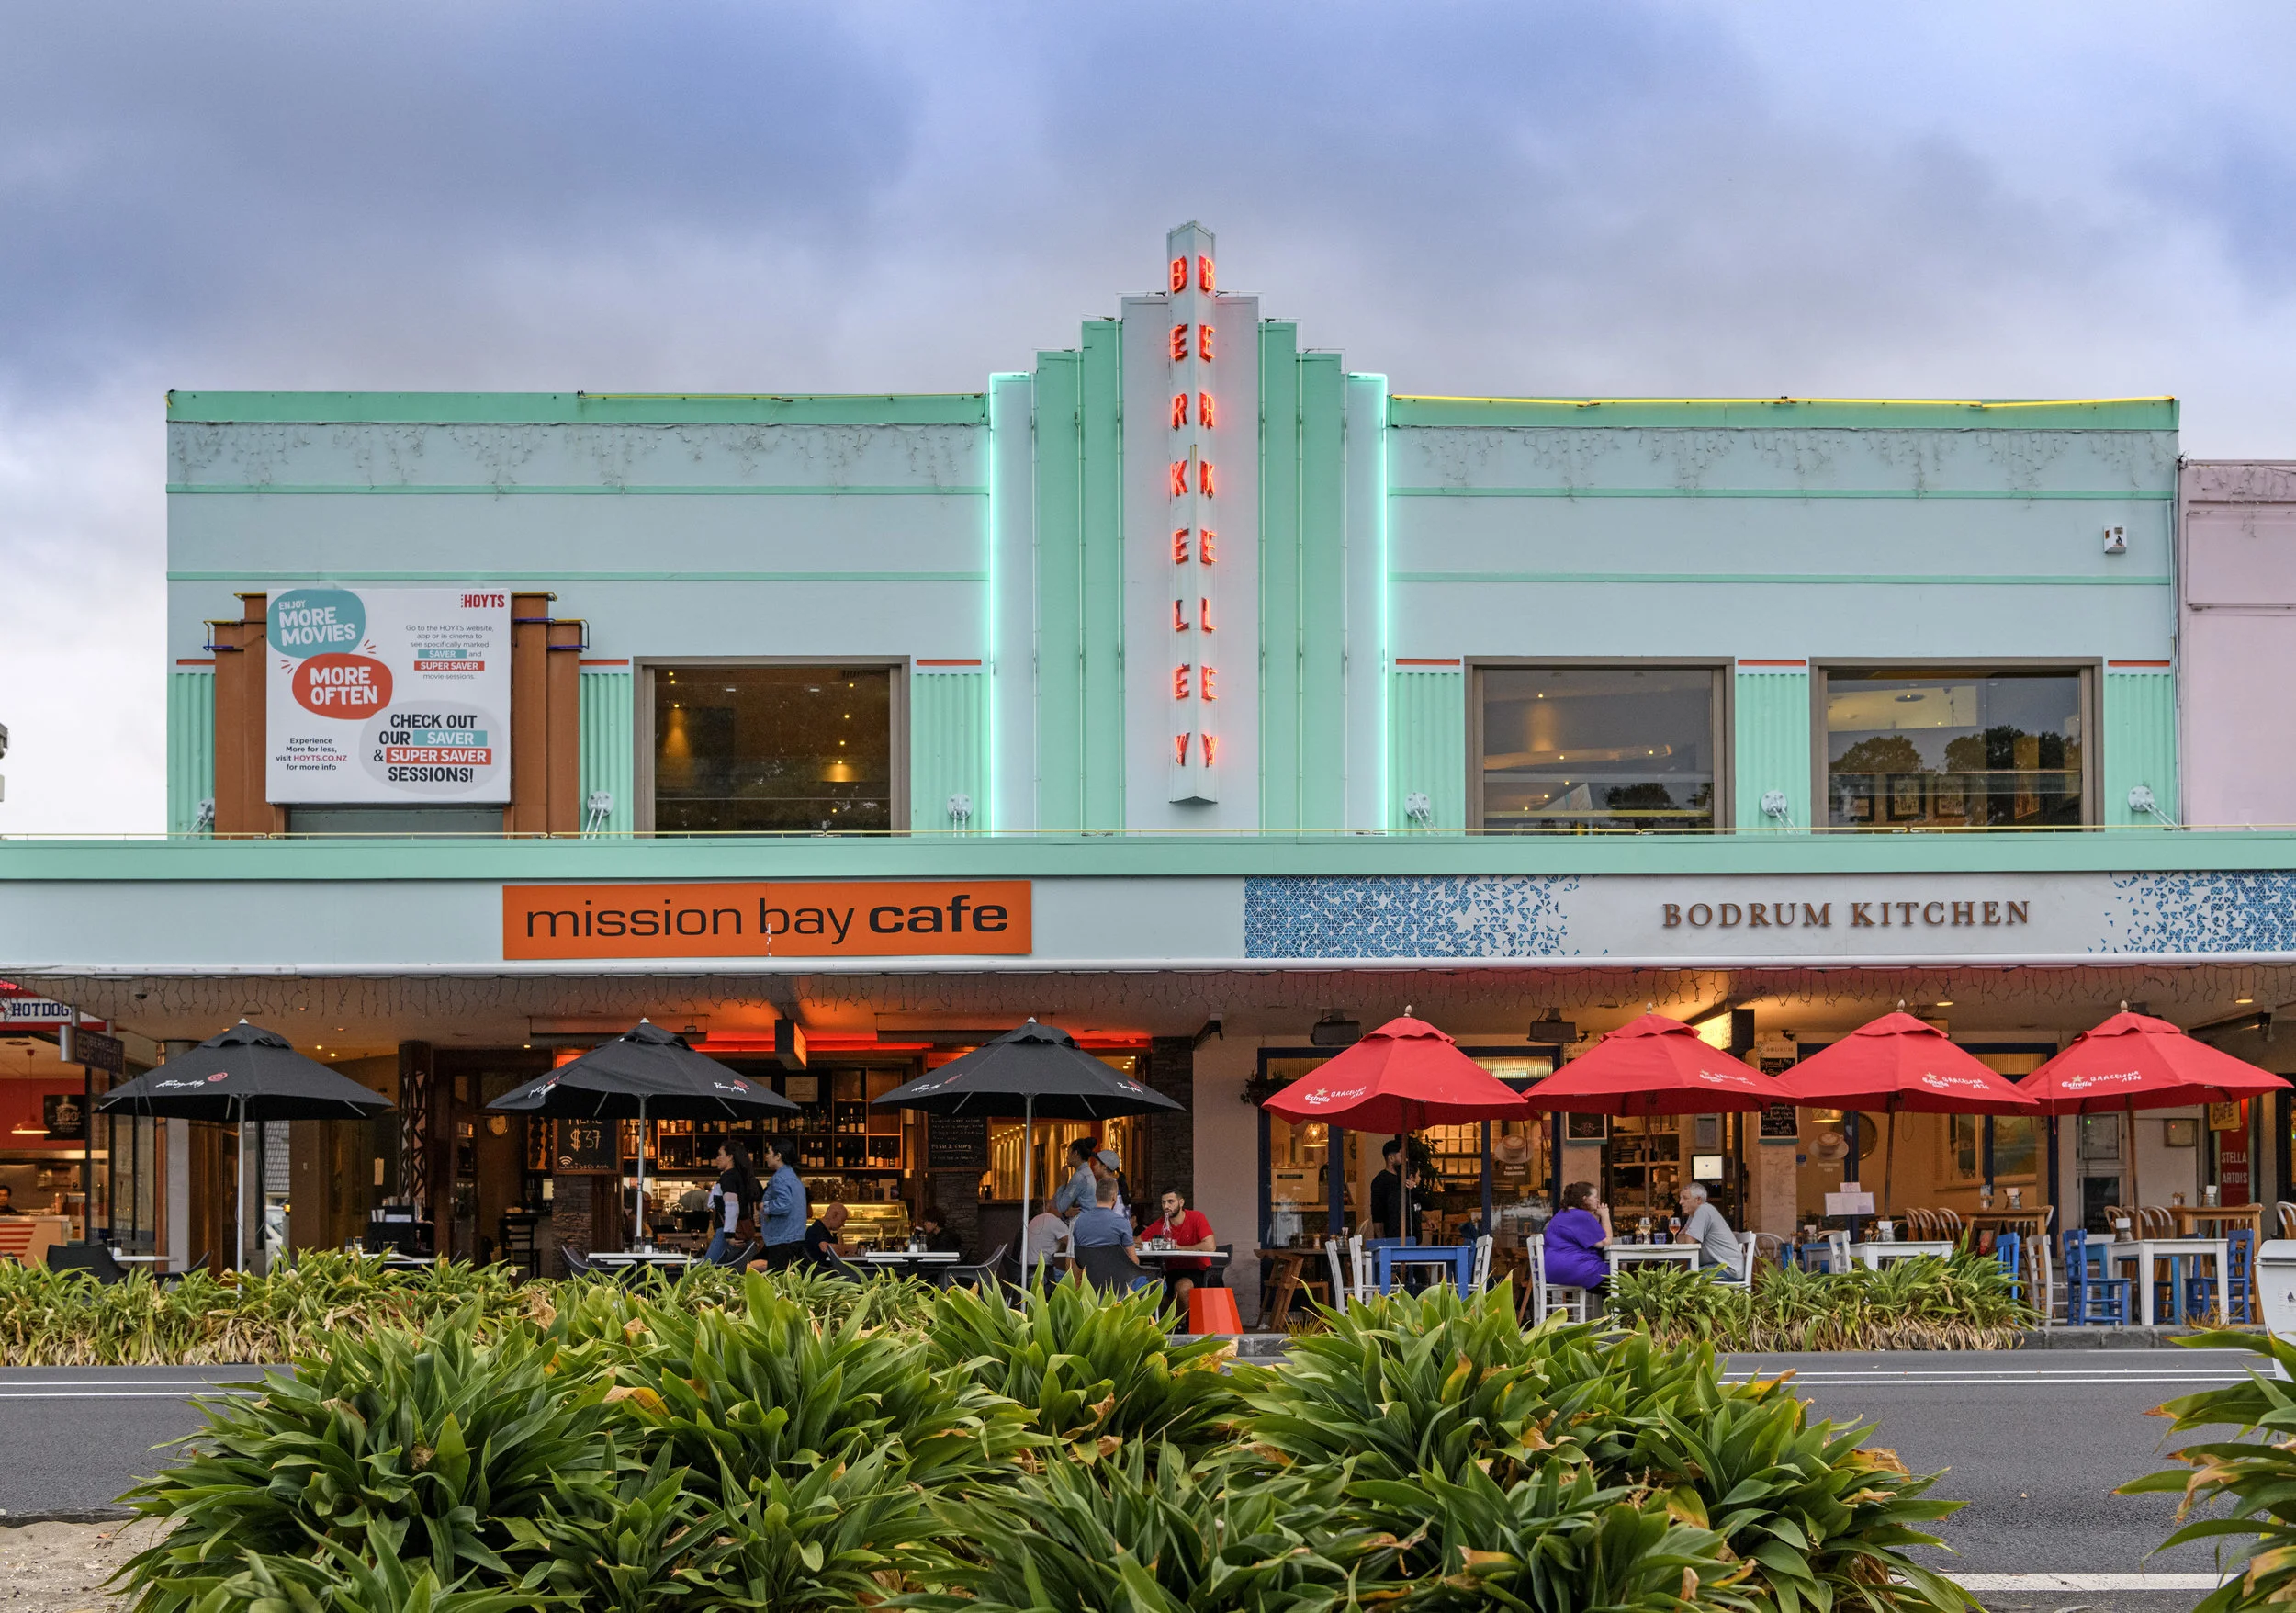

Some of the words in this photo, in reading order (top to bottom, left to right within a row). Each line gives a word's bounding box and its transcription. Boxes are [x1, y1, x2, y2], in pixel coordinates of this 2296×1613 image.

[1169, 255, 1190, 766] BERKELEY
[1199, 254, 1219, 767] BERKELEY
[279, 600, 306, 610] ENJOY
[464, 594, 505, 608] HOYTS
[279, 607, 337, 628] MORE
[281, 623, 356, 646] MOVIES
[421, 662, 449, 670] SUPER
[451, 662, 479, 670] SAVER
[310, 666, 371, 685] MORE
[310, 686, 378, 705] OFTEN
[390, 714, 442, 728] CHECK
[446, 715, 477, 729] OUT
[379, 731, 411, 745] OUR
[427, 732, 474, 745] SAVER
[373, 749, 384, 762] &
[390, 749, 438, 762] SUPER
[440, 750, 487, 763] SAVER
[388, 767, 473, 783] SESSIONS!
[526, 899, 742, 937] mission
[759, 897, 855, 945] bay
[868, 894, 1009, 934] cafe
[1661, 902, 1833, 927] BODRUM
[1850, 900, 2031, 927] KITCHEN
[11, 1003, 73, 1016] HOTDOG
[2221, 1151, 2247, 1163] STELLA
[2222, 1172, 2248, 1184] ARTOIS
